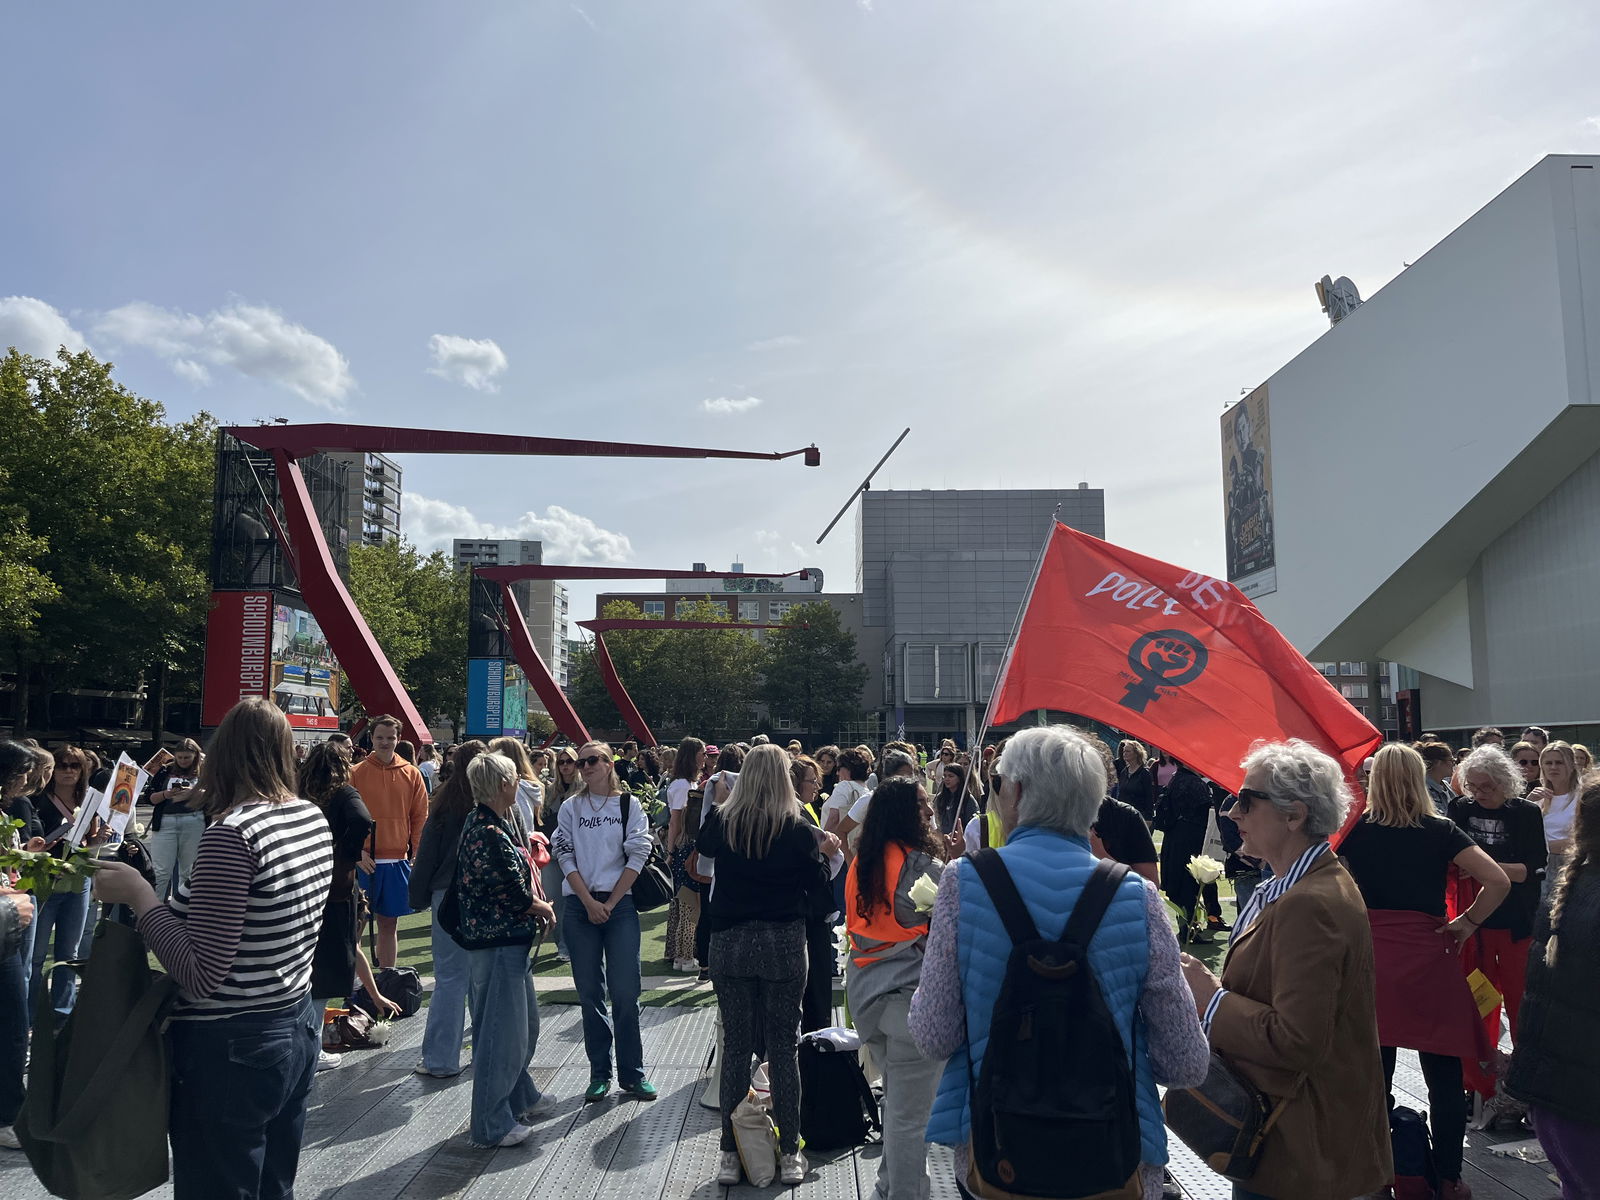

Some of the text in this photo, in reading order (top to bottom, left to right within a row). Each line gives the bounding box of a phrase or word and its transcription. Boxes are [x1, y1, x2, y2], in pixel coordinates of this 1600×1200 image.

[1085, 571, 1182, 615] DOLLE
[486, 661, 502, 729] SCHOUWBURGPLEIN
[579, 816, 602, 829] DOLLE
